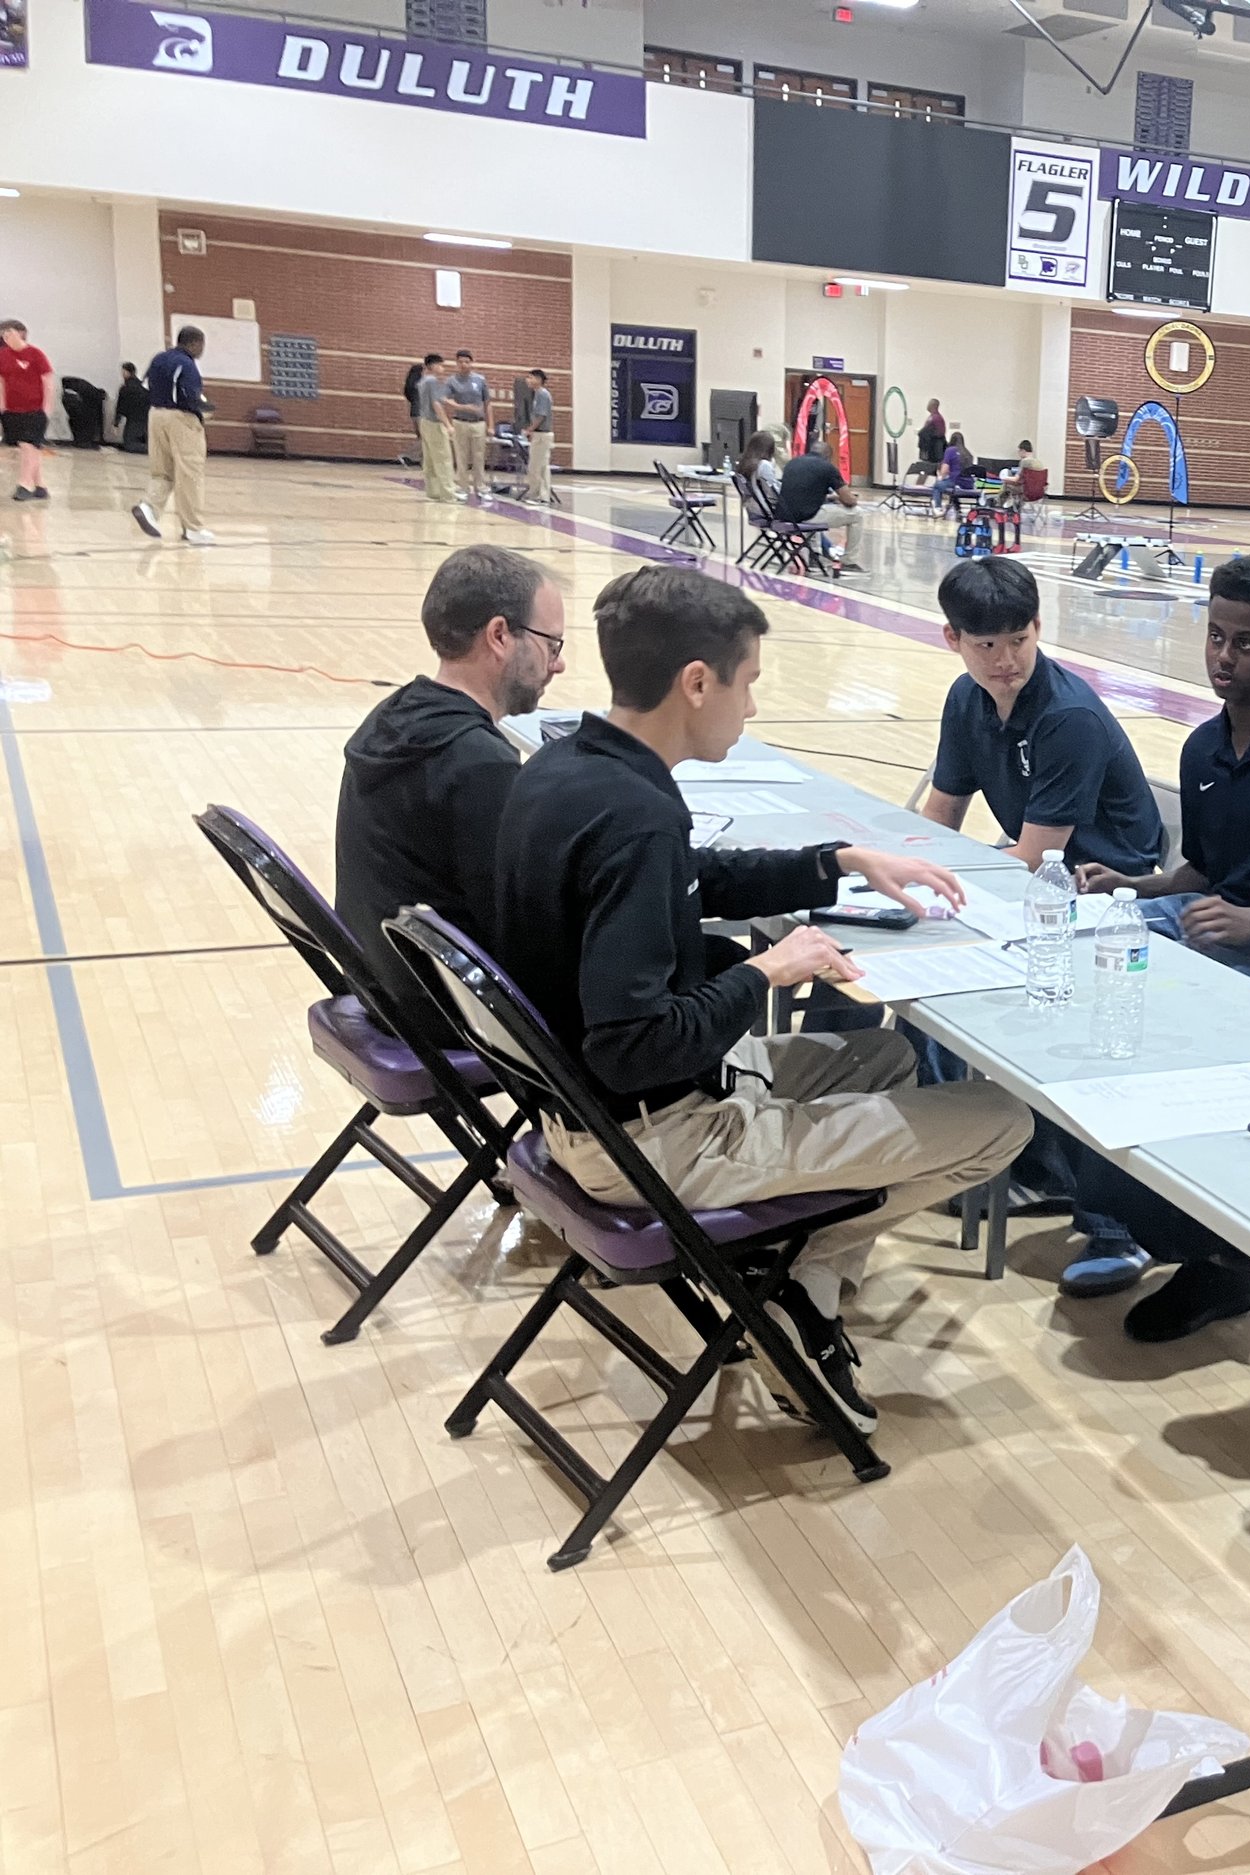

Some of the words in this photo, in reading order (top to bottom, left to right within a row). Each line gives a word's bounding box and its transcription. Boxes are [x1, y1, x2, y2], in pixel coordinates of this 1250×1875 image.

[277, 33, 595, 121] DULUTH
[1017, 159, 1089, 180] FLAGLER
[1018, 180, 1085, 243] 5
[613, 334, 684, 352] DULUTH
